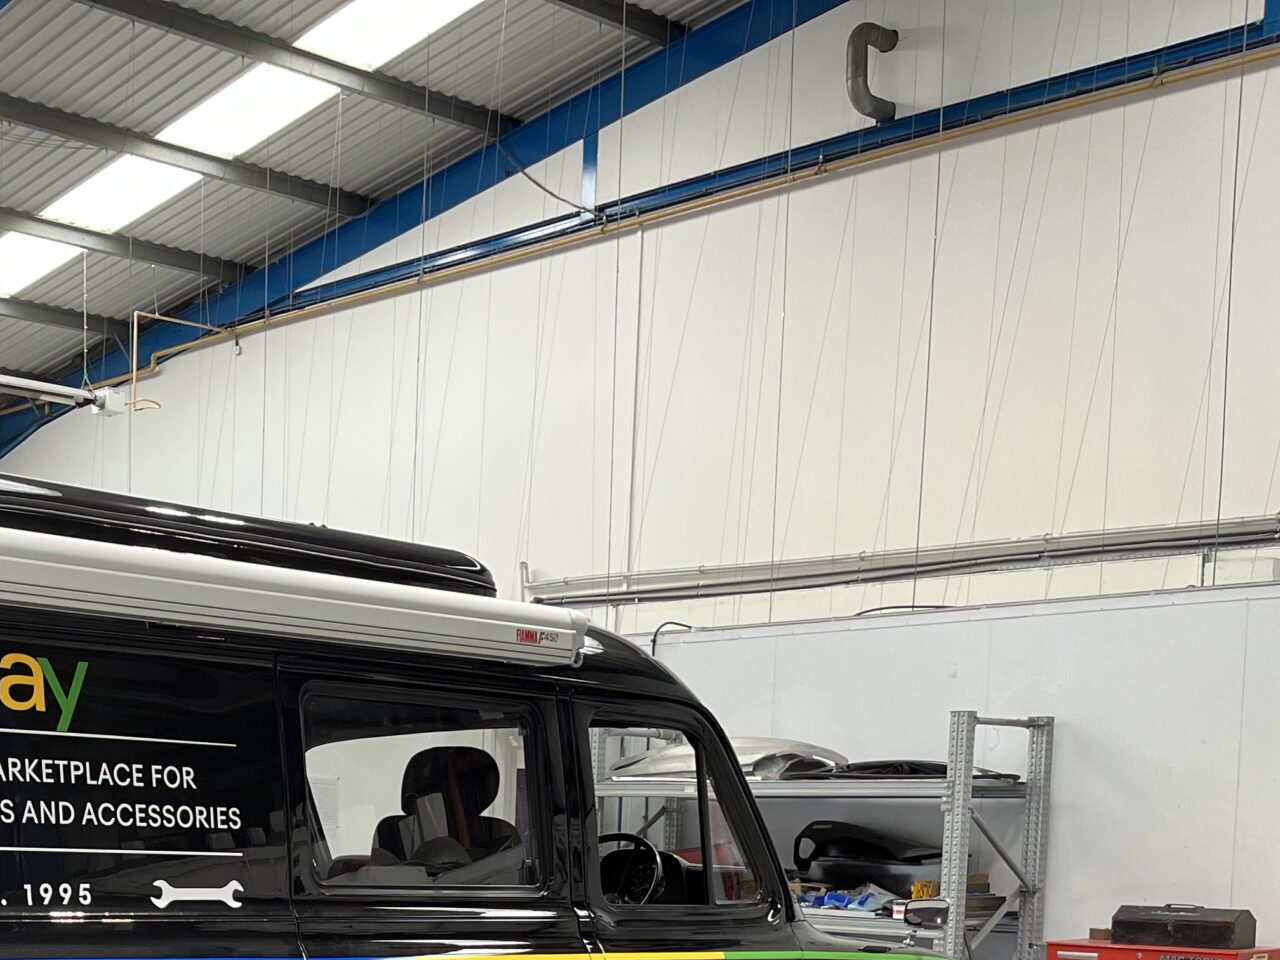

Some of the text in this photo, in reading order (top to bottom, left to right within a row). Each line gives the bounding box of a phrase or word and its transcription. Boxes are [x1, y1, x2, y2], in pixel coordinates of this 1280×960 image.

[151, 765, 197, 789] FOR
[21, 800, 75, 824] AND
[81, 803, 242, 829] ACCESSORIES
[23, 883, 92, 906] 1995
